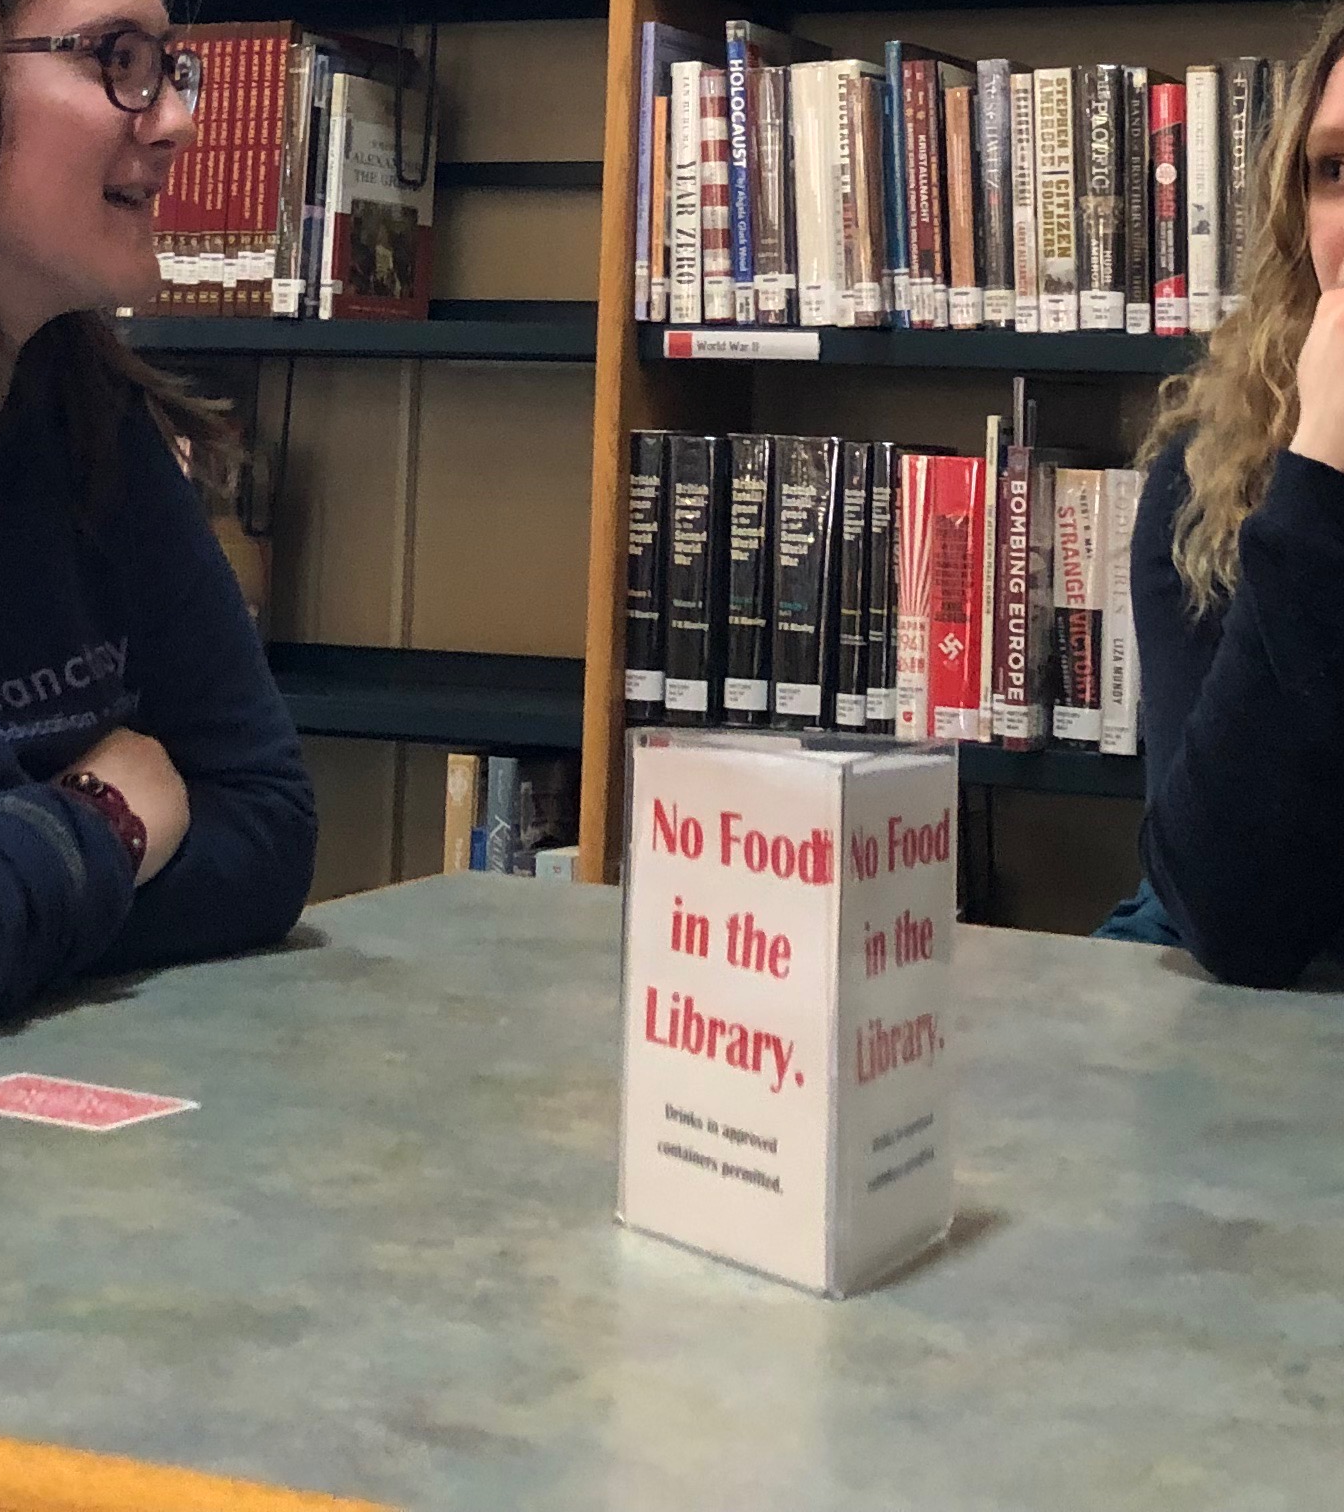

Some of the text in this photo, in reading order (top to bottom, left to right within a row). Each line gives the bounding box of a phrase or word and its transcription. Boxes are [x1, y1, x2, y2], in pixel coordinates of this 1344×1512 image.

[729, 58, 748, 168] HOLOCAUST
[1040, 78, 1054, 167] AMBROSE
[1055, 77, 1068, 148] STEPHEN
[1090, 100, 1110, 188] PACIFIC
[1232, 70, 1248, 194] FLYBOYS
[918, 134, 930, 223] KRISTALLNACHT
[1130, 99, 1142, 228] BAND BROTHERS
[675, 161, 697, 286] YEAR ZERO
[1042, 180, 1055, 258] SOLDIERS
[1057, 180, 1072, 258] CITIZEN
[1103, 250, 1112, 284] HUGH
[697, 340, 727, 352] World
[730, 341, 749, 352] War
[1007, 479, 1027, 702] BOMBING EUROPE
[1057, 506, 1097, 704] STRANGE VICTORY
[1111, 638, 1125, 705] LIZA MUNDY
[652, 796, 834, 886] No Food
[887, 807, 951, 874] Food
[670, 894, 792, 981] in the
[864, 909, 934, 980] in the
[644, 985, 805, 1094] Library.
[656, 1139, 719, 1174] containers
[665, 1102, 779, 1155] Drinks in approved
